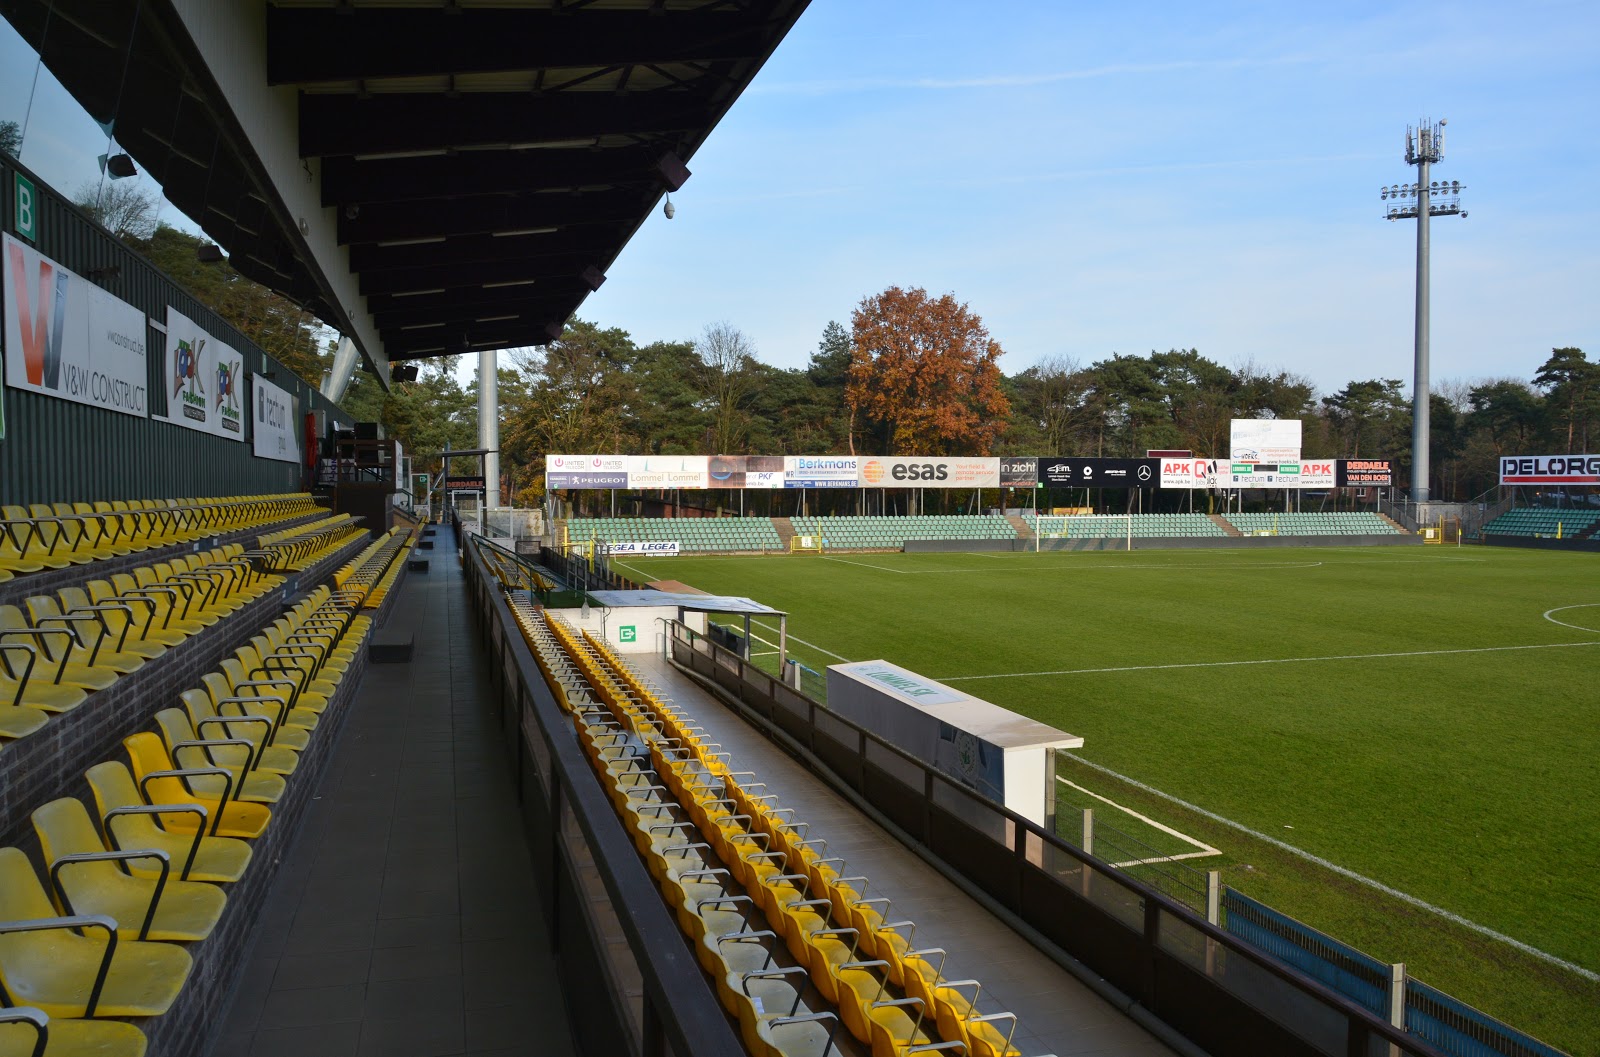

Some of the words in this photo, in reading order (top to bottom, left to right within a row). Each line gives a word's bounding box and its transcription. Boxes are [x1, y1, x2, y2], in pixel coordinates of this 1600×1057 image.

[19, 184, 32, 232] B
[63, 361, 89, 397] V&W
[91, 371, 146, 412] CONSTRUCT
[799, 459, 856, 468] Berkmans
[1001, 462, 1010, 472] in
[1011, 462, 1036, 473] zicht
[1164, 464, 1190, 473] APK
[892, 464, 948, 480] esas
[1302, 465, 1331, 474] APK
[669, 473, 700, 481] Lommel
[758, 472, 774, 480] PKF
[865, 671, 921, 690] LOMMEL
[904, 688, 938, 696] SK
